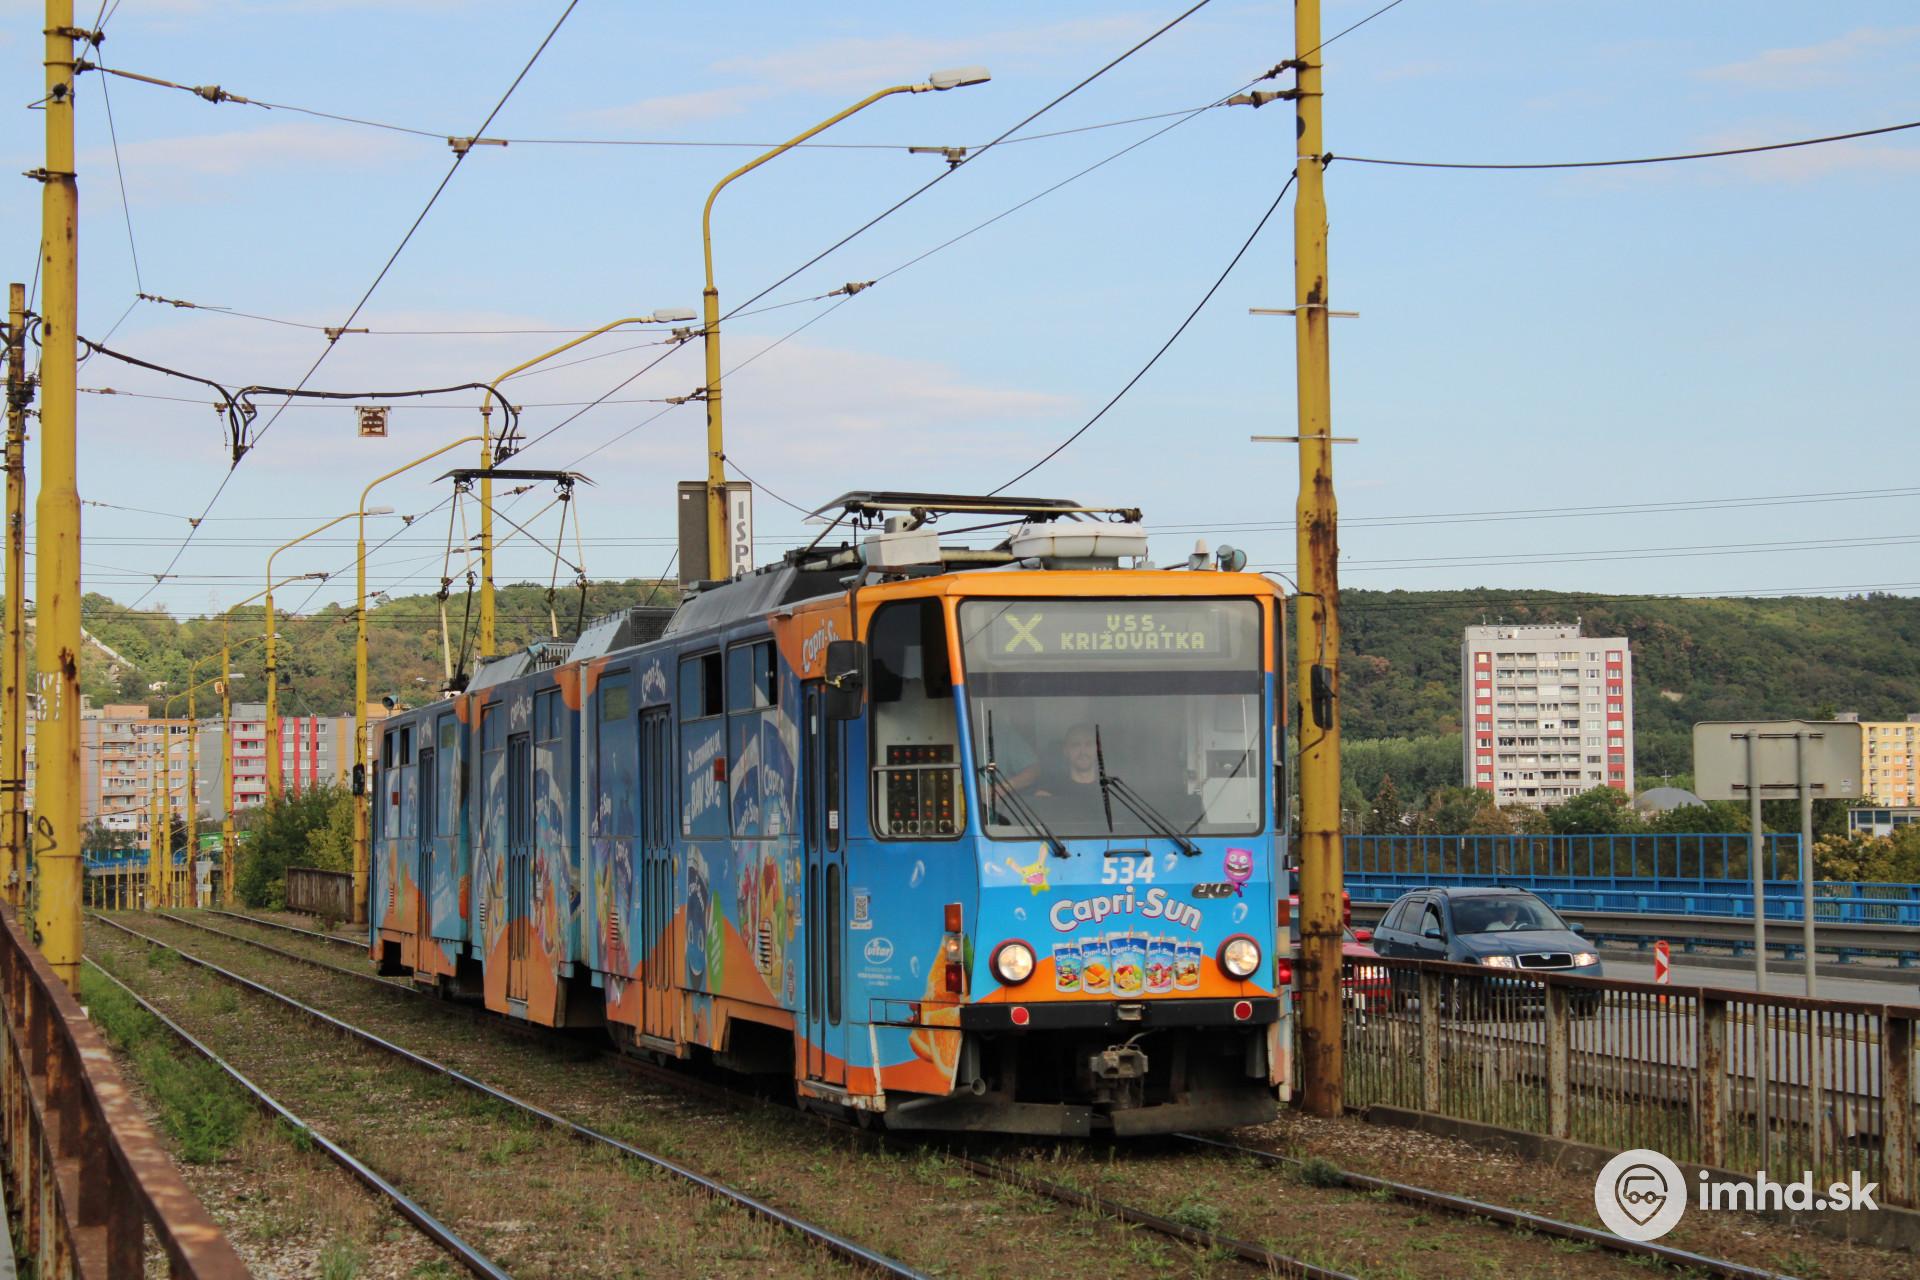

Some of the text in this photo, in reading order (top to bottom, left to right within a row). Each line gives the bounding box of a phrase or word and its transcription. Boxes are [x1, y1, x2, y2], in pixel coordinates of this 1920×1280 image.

[1005, 613, 1043, 652] X
[1106, 614, 1166, 632] VSS,
[1060, 630, 1205, 650] KRIŽOVATKA
[1101, 856, 1156, 885] 534
[1050, 885, 1202, 932] Capri-Sun
